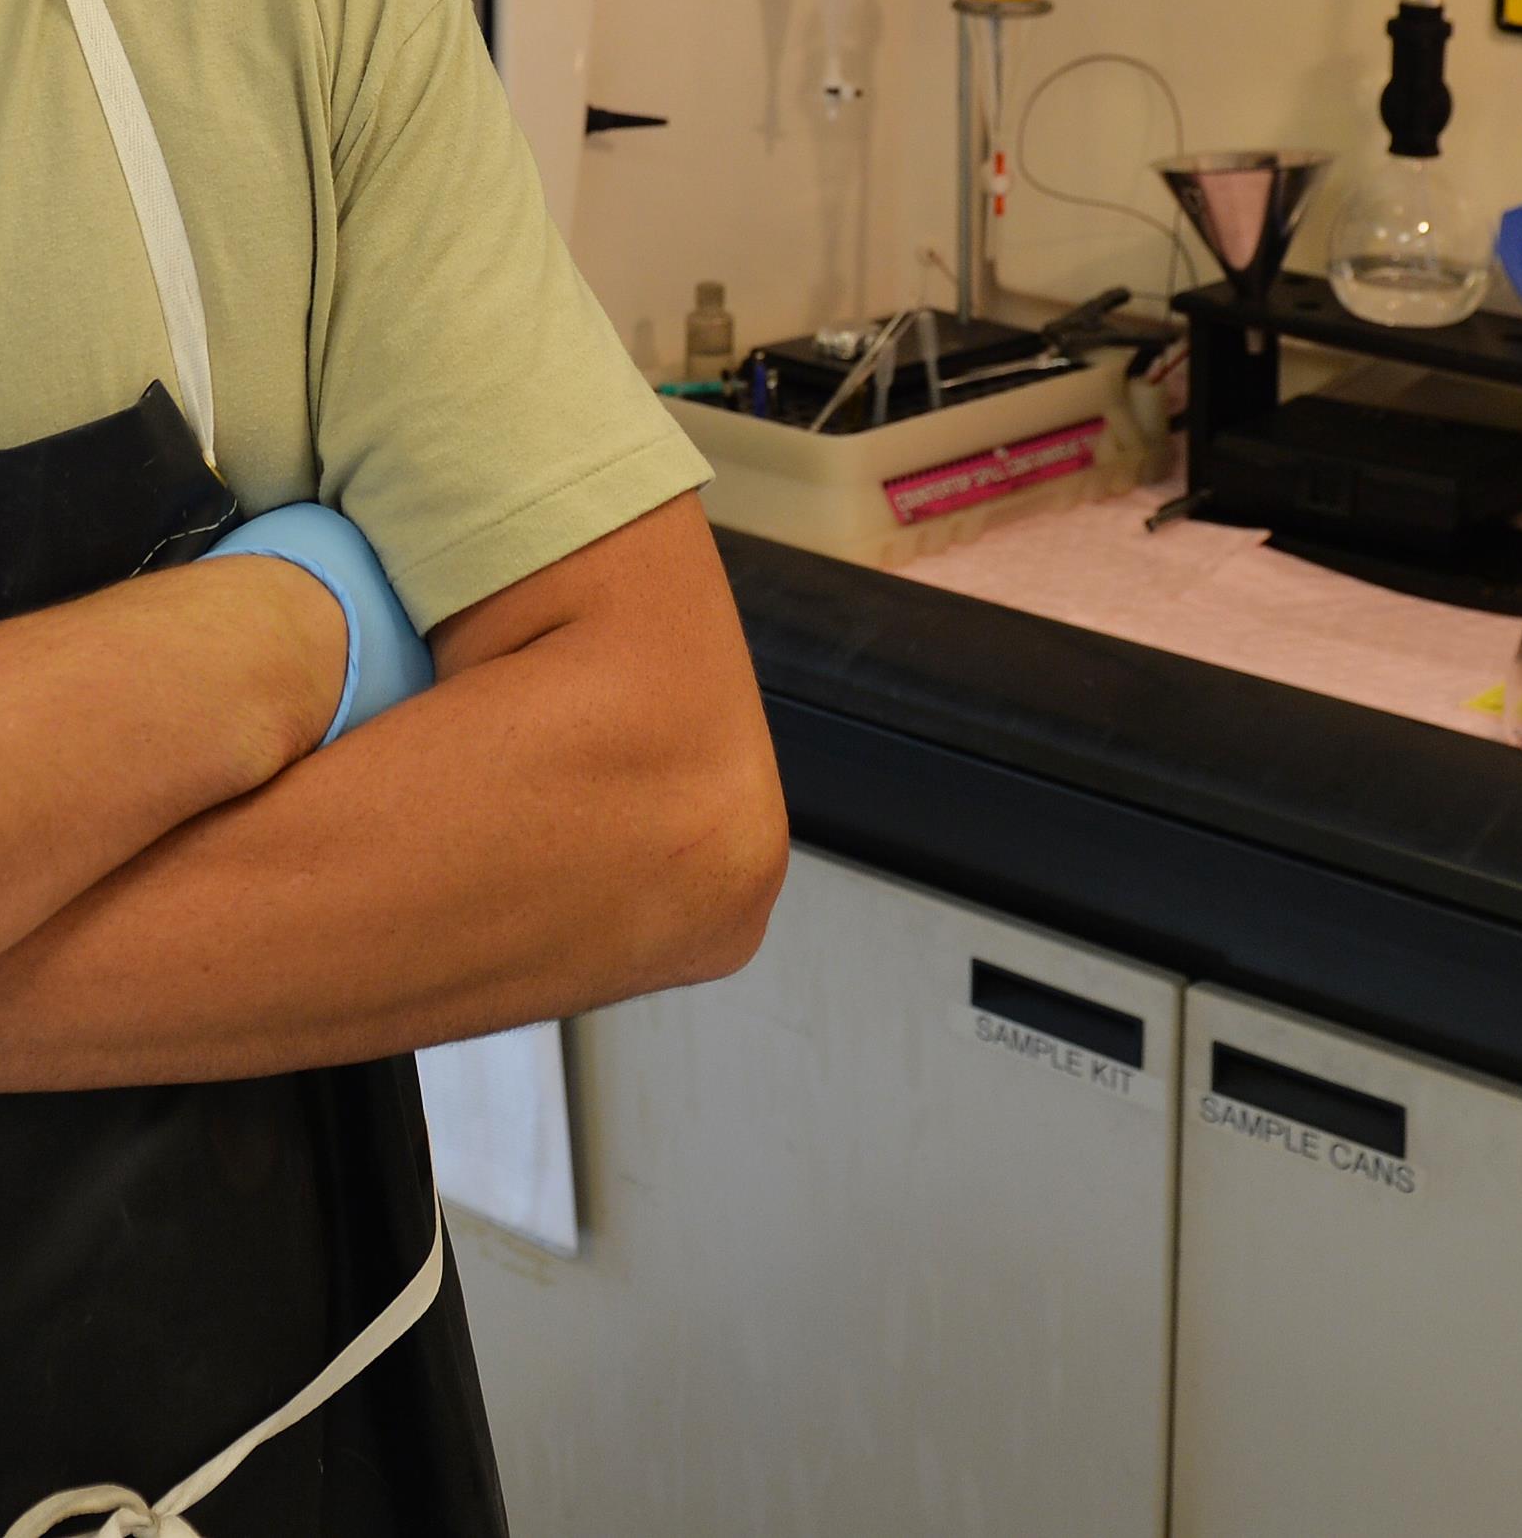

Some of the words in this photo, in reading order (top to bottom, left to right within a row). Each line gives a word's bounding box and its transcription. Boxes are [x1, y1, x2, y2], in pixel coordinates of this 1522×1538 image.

[977, 1015, 1082, 1078] SAMPLE
[1090, 1059, 1137, 1096] KIT
[1199, 1095, 1320, 1162] SAMPLE
[1328, 1143, 1415, 1195] CANS
